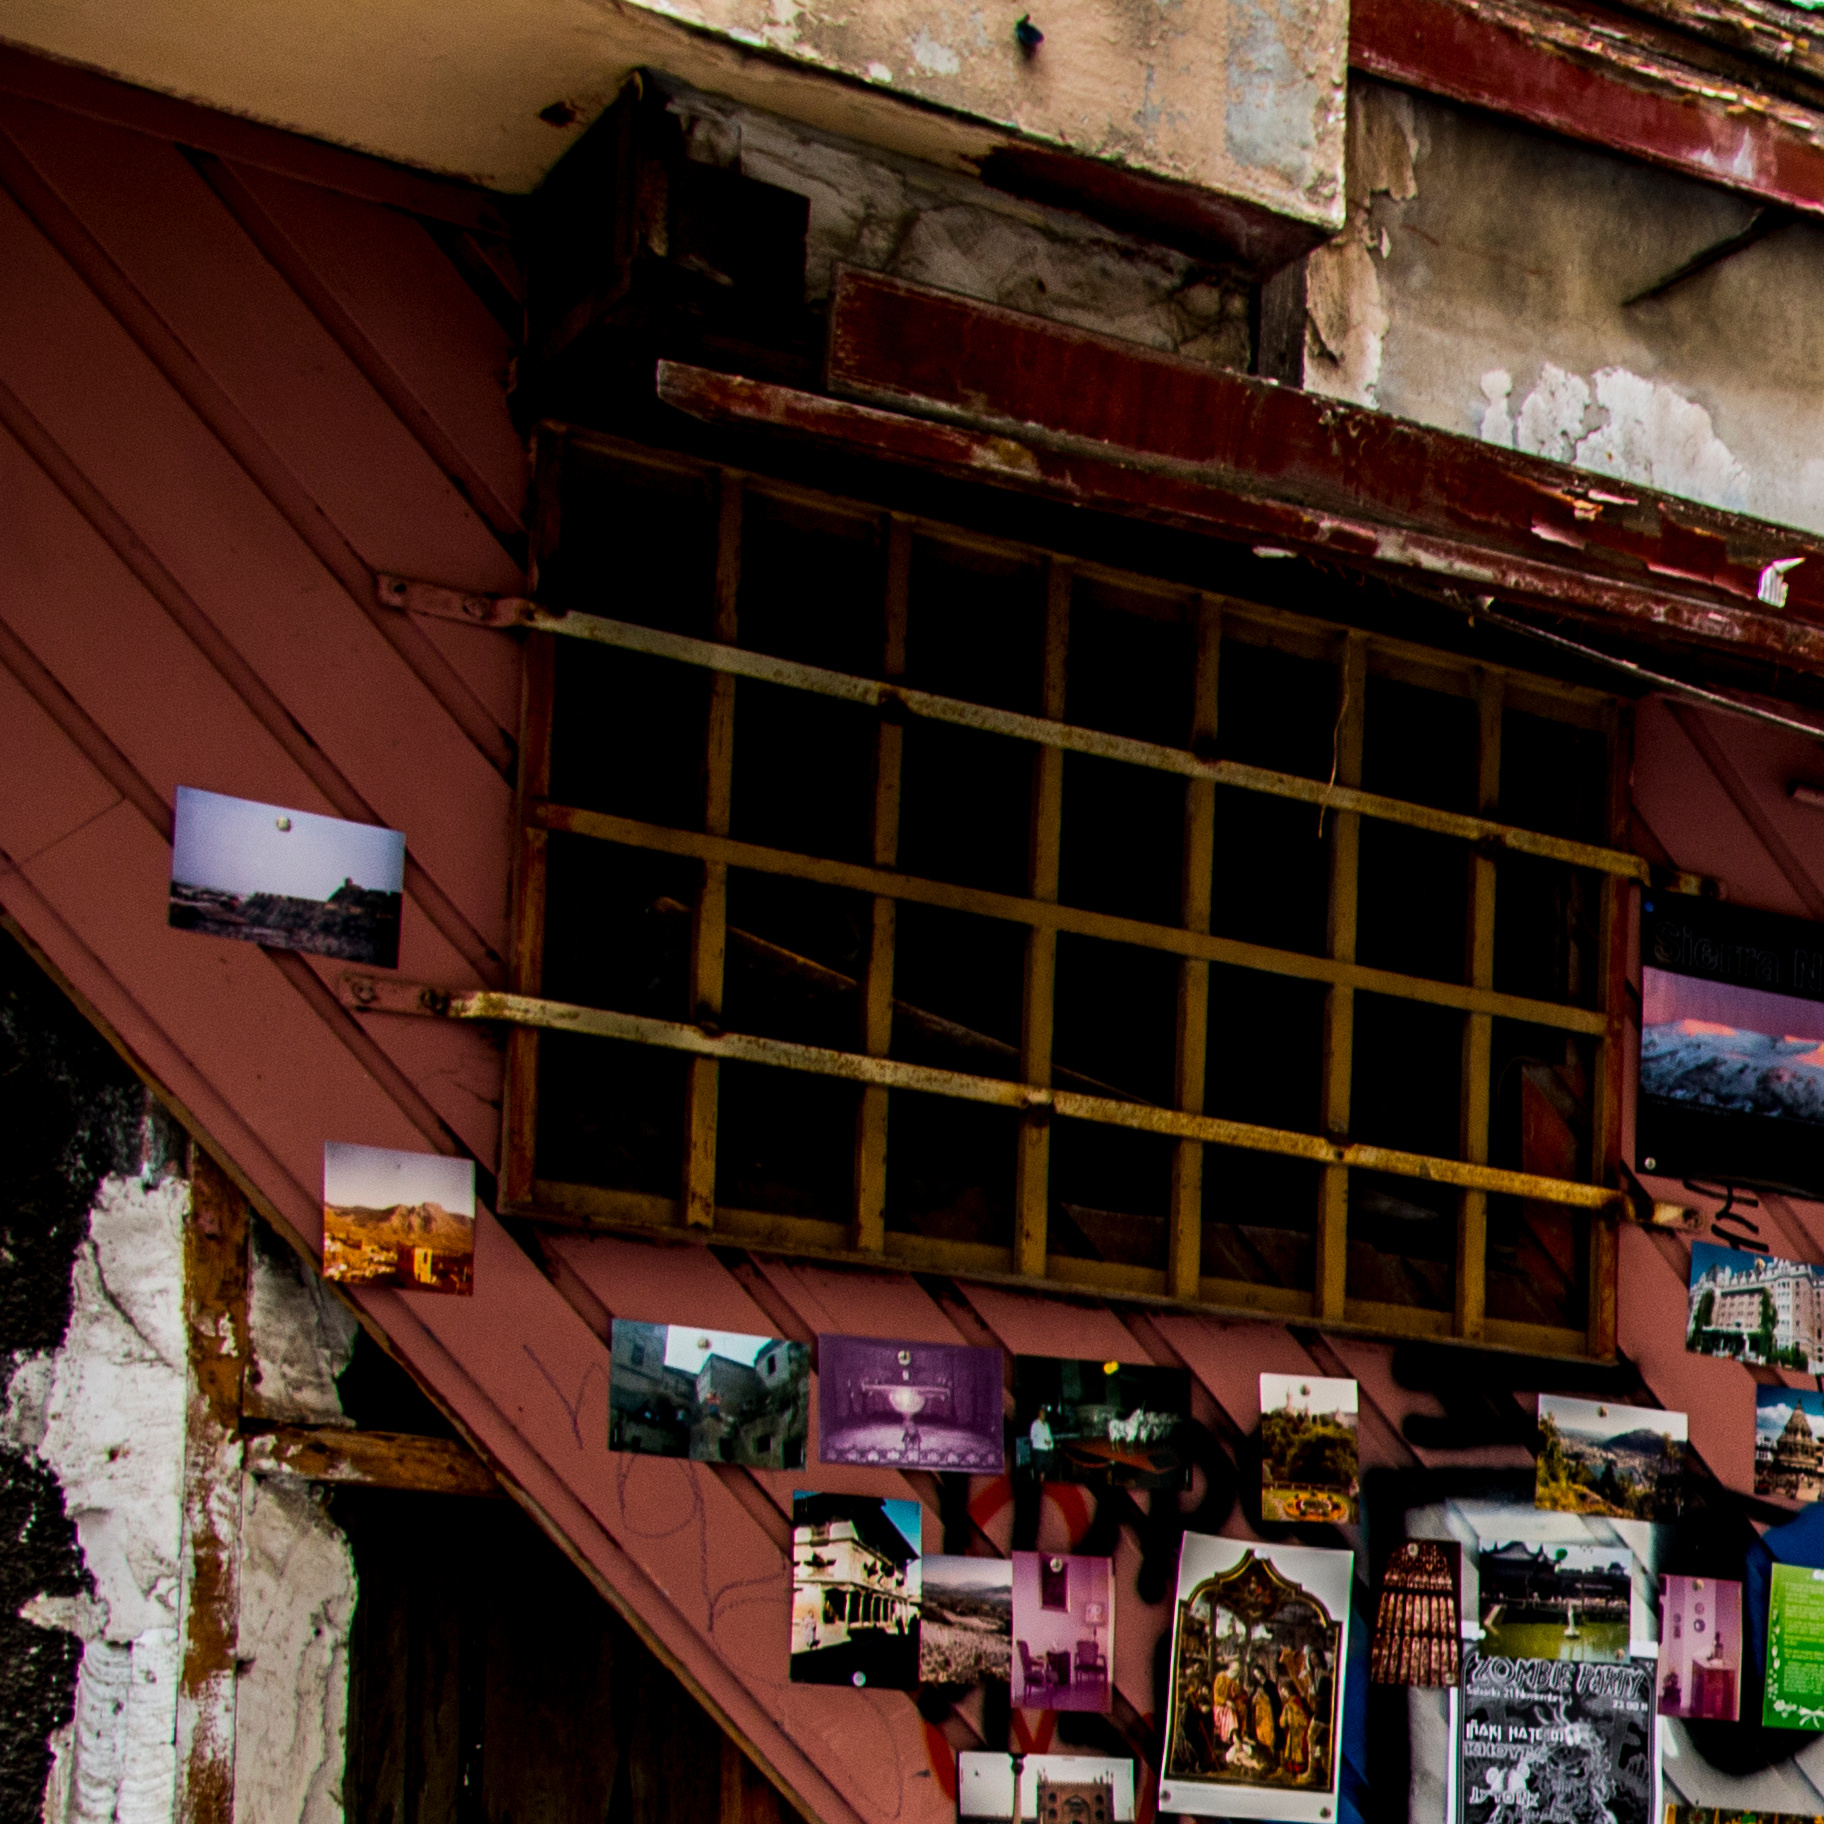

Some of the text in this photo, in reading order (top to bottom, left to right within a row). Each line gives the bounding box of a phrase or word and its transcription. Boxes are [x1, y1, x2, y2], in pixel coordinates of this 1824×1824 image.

[1652, 920, 1780, 984] Sierra
[1464, 1654, 1647, 1699] ZOMBIE PARTY
